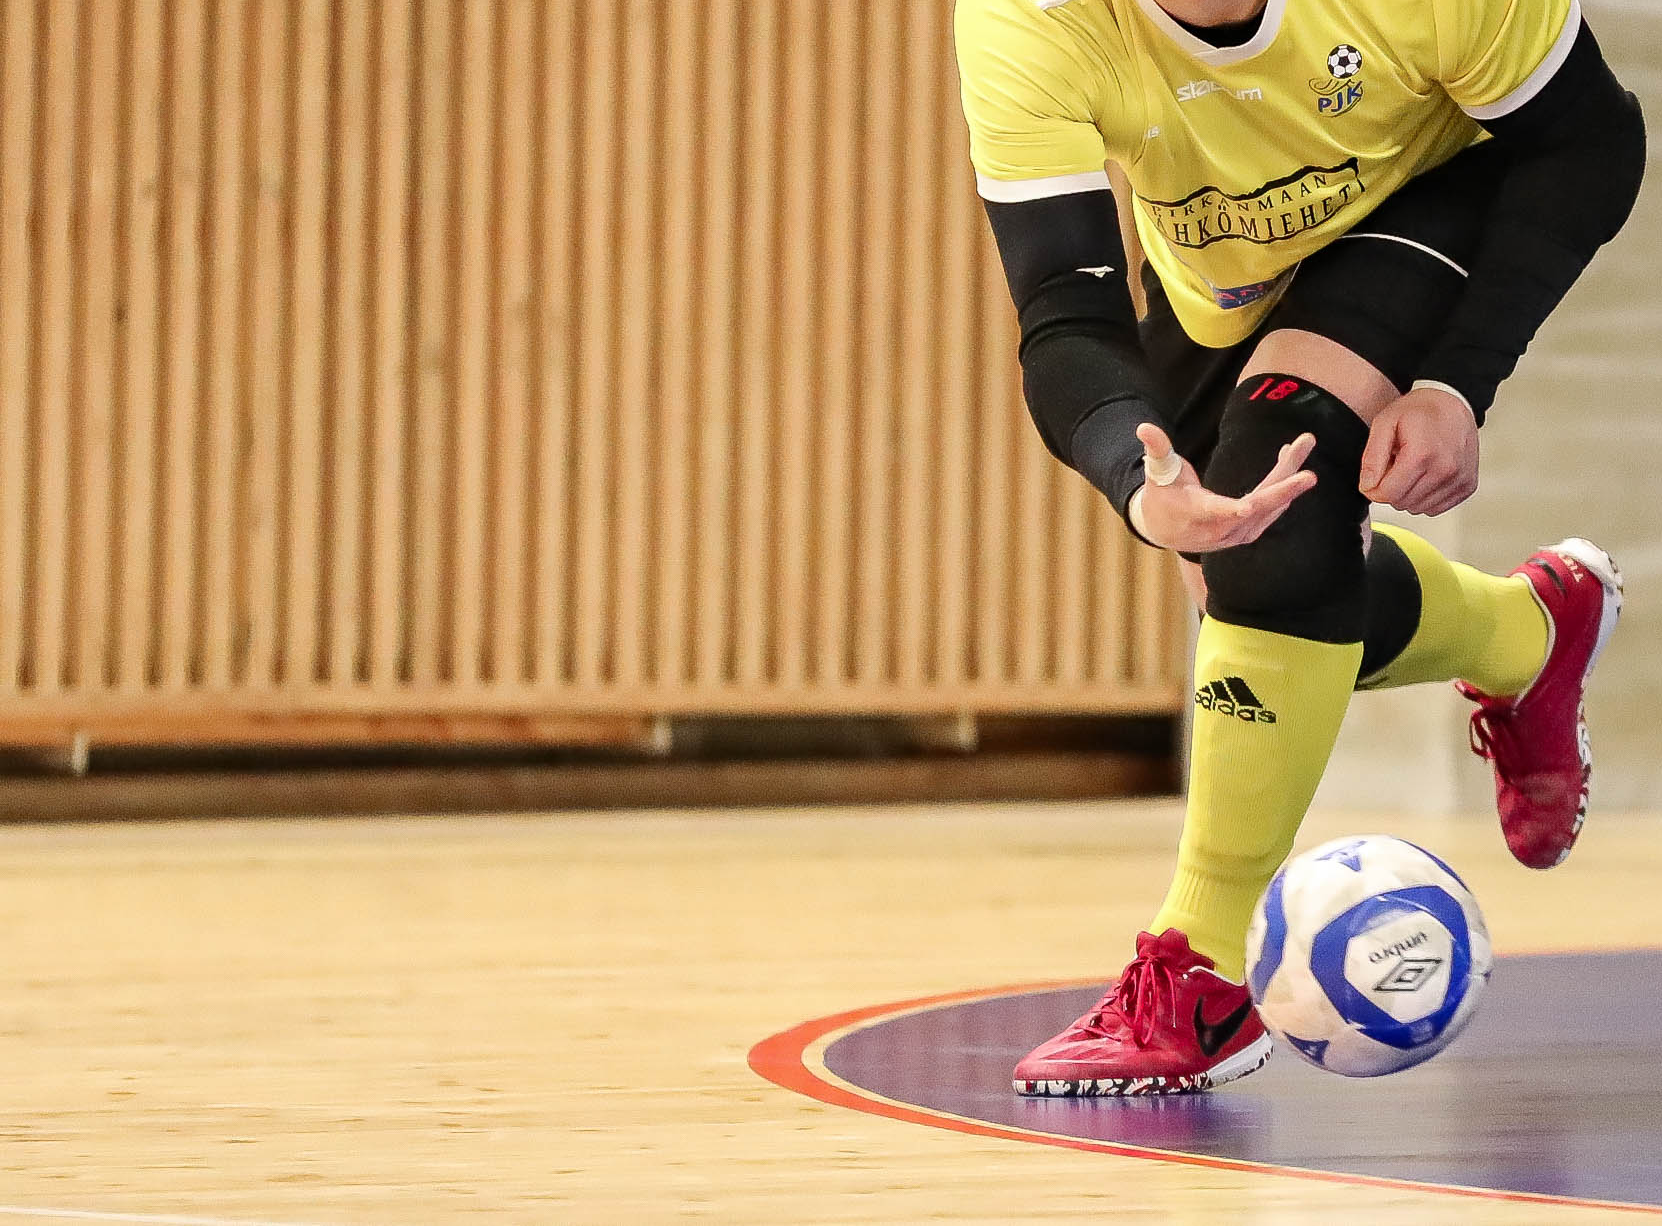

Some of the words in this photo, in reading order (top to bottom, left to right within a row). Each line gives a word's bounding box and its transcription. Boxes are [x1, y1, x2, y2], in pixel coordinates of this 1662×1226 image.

[1317, 80, 1363, 113] PJK
[1151, 174, 1327, 218] PIRKANMAAN
[1249, 377, 1300, 401] 18
[1194, 689, 1277, 724] adidas
